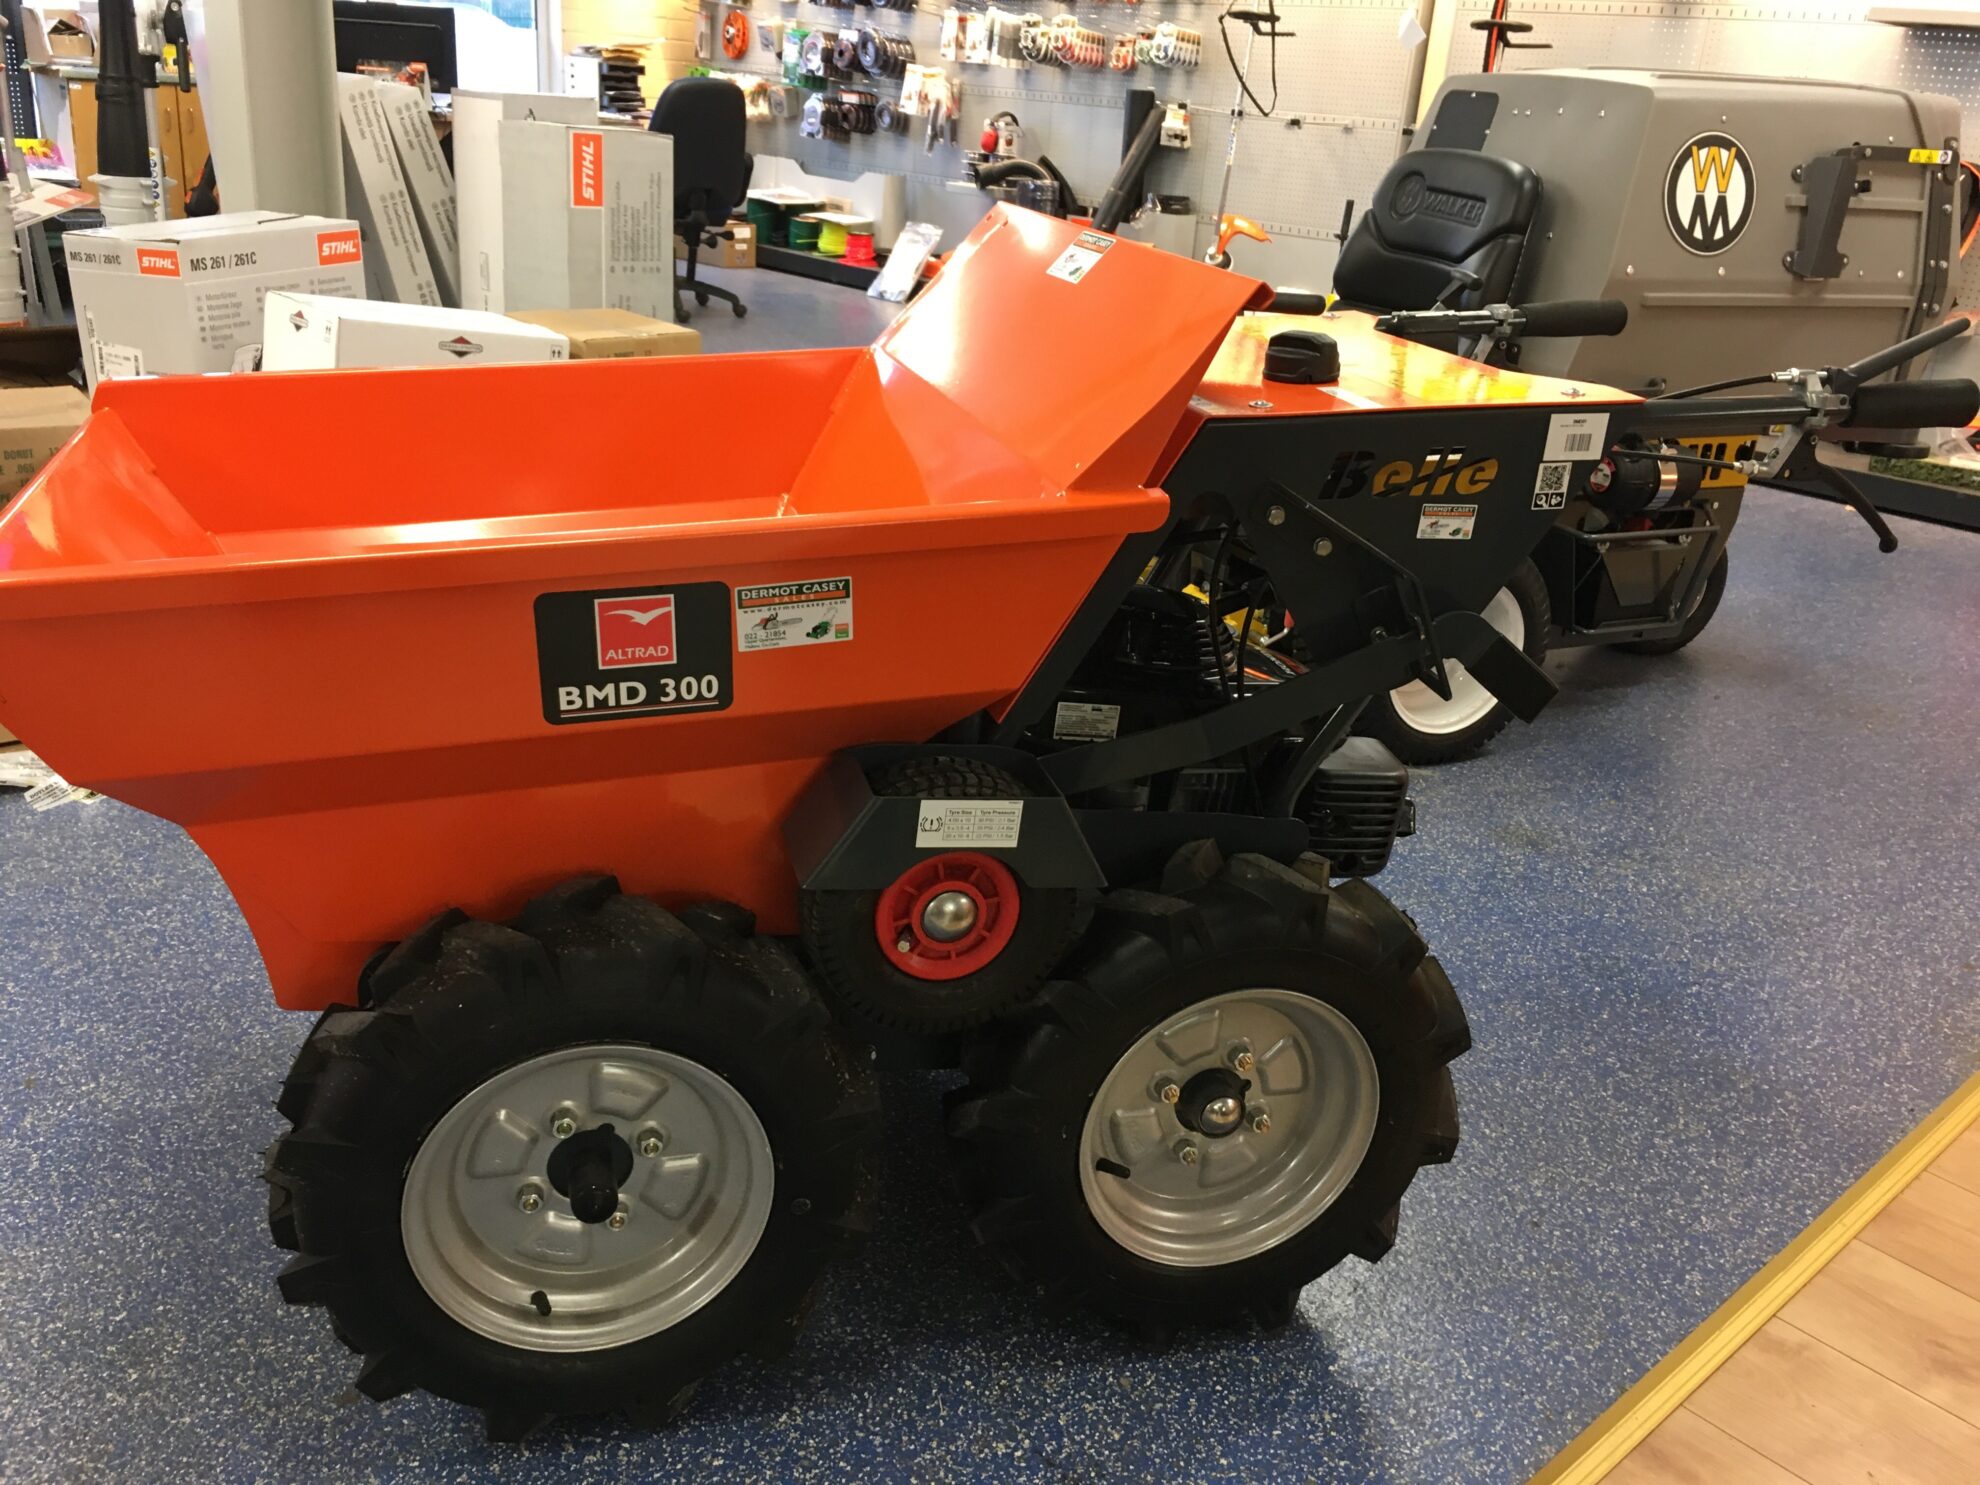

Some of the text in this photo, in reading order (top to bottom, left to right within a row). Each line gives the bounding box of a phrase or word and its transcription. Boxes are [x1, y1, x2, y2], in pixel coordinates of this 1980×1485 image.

[582, 141, 595, 201] STIHL
[1424, 191, 1483, 221] WALKER
[321, 239, 357, 257] STIHL
[70, 251, 83, 262] MS
[84, 252, 97, 263] 261
[103, 254, 122, 266] 261C
[141, 256, 175, 269] STIHL
[190, 258, 208, 272] MS
[210, 256, 226, 270] 261
[234, 251, 257, 267] 261C
[1318, 446, 1499, 499] Belle
[742, 581, 845, 599] DERMOT CASEY
[774, 594, 815, 603] SALES
[765, 630, 786, 638] 21854
[605, 645, 669, 661] ALTRAD
[558, 674, 719, 710] BMD 300
